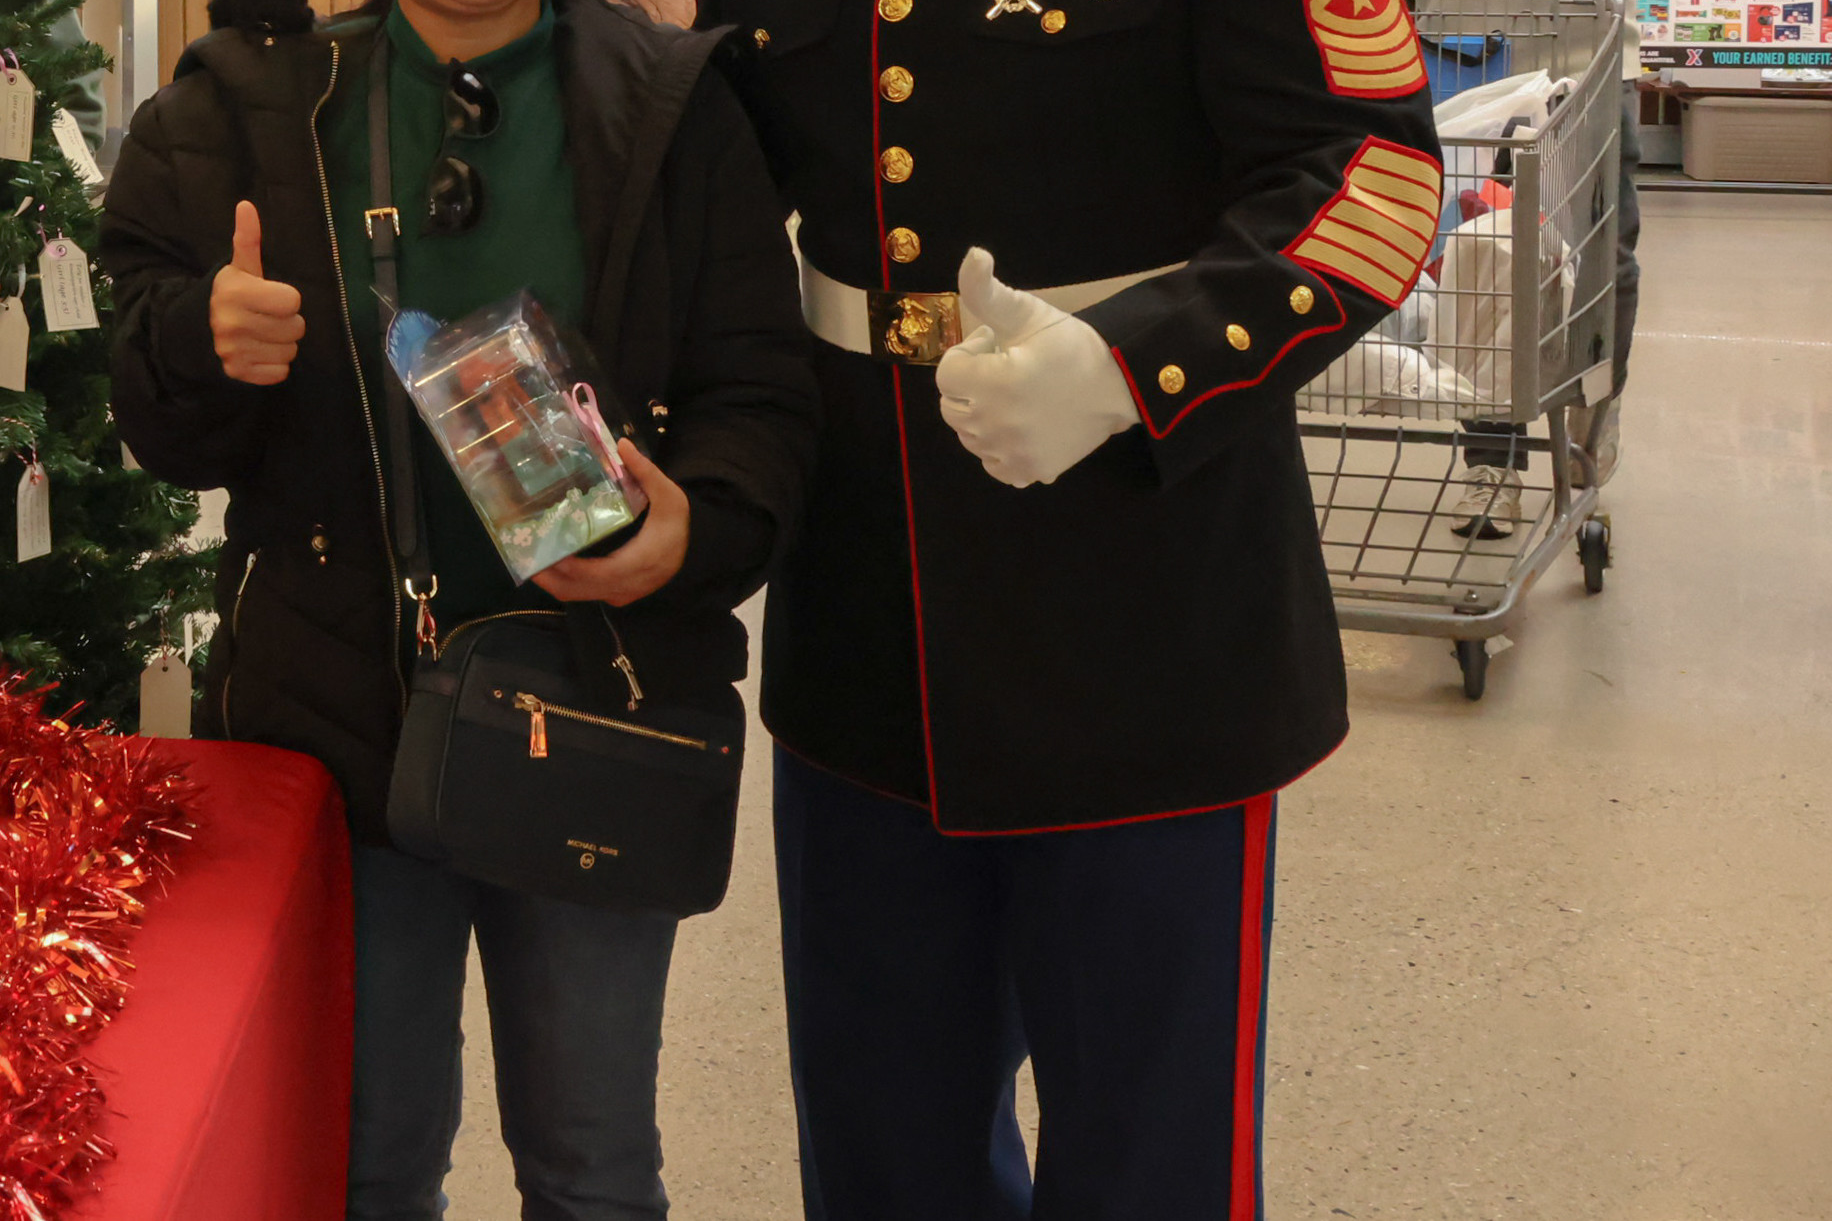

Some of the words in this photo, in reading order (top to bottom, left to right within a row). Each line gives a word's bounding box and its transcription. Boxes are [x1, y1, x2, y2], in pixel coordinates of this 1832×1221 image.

[1713, 52, 1741, 64] YOUR
[1743, 52, 1785, 65] EARNED
[567, 839, 597, 851] MICHAEL
